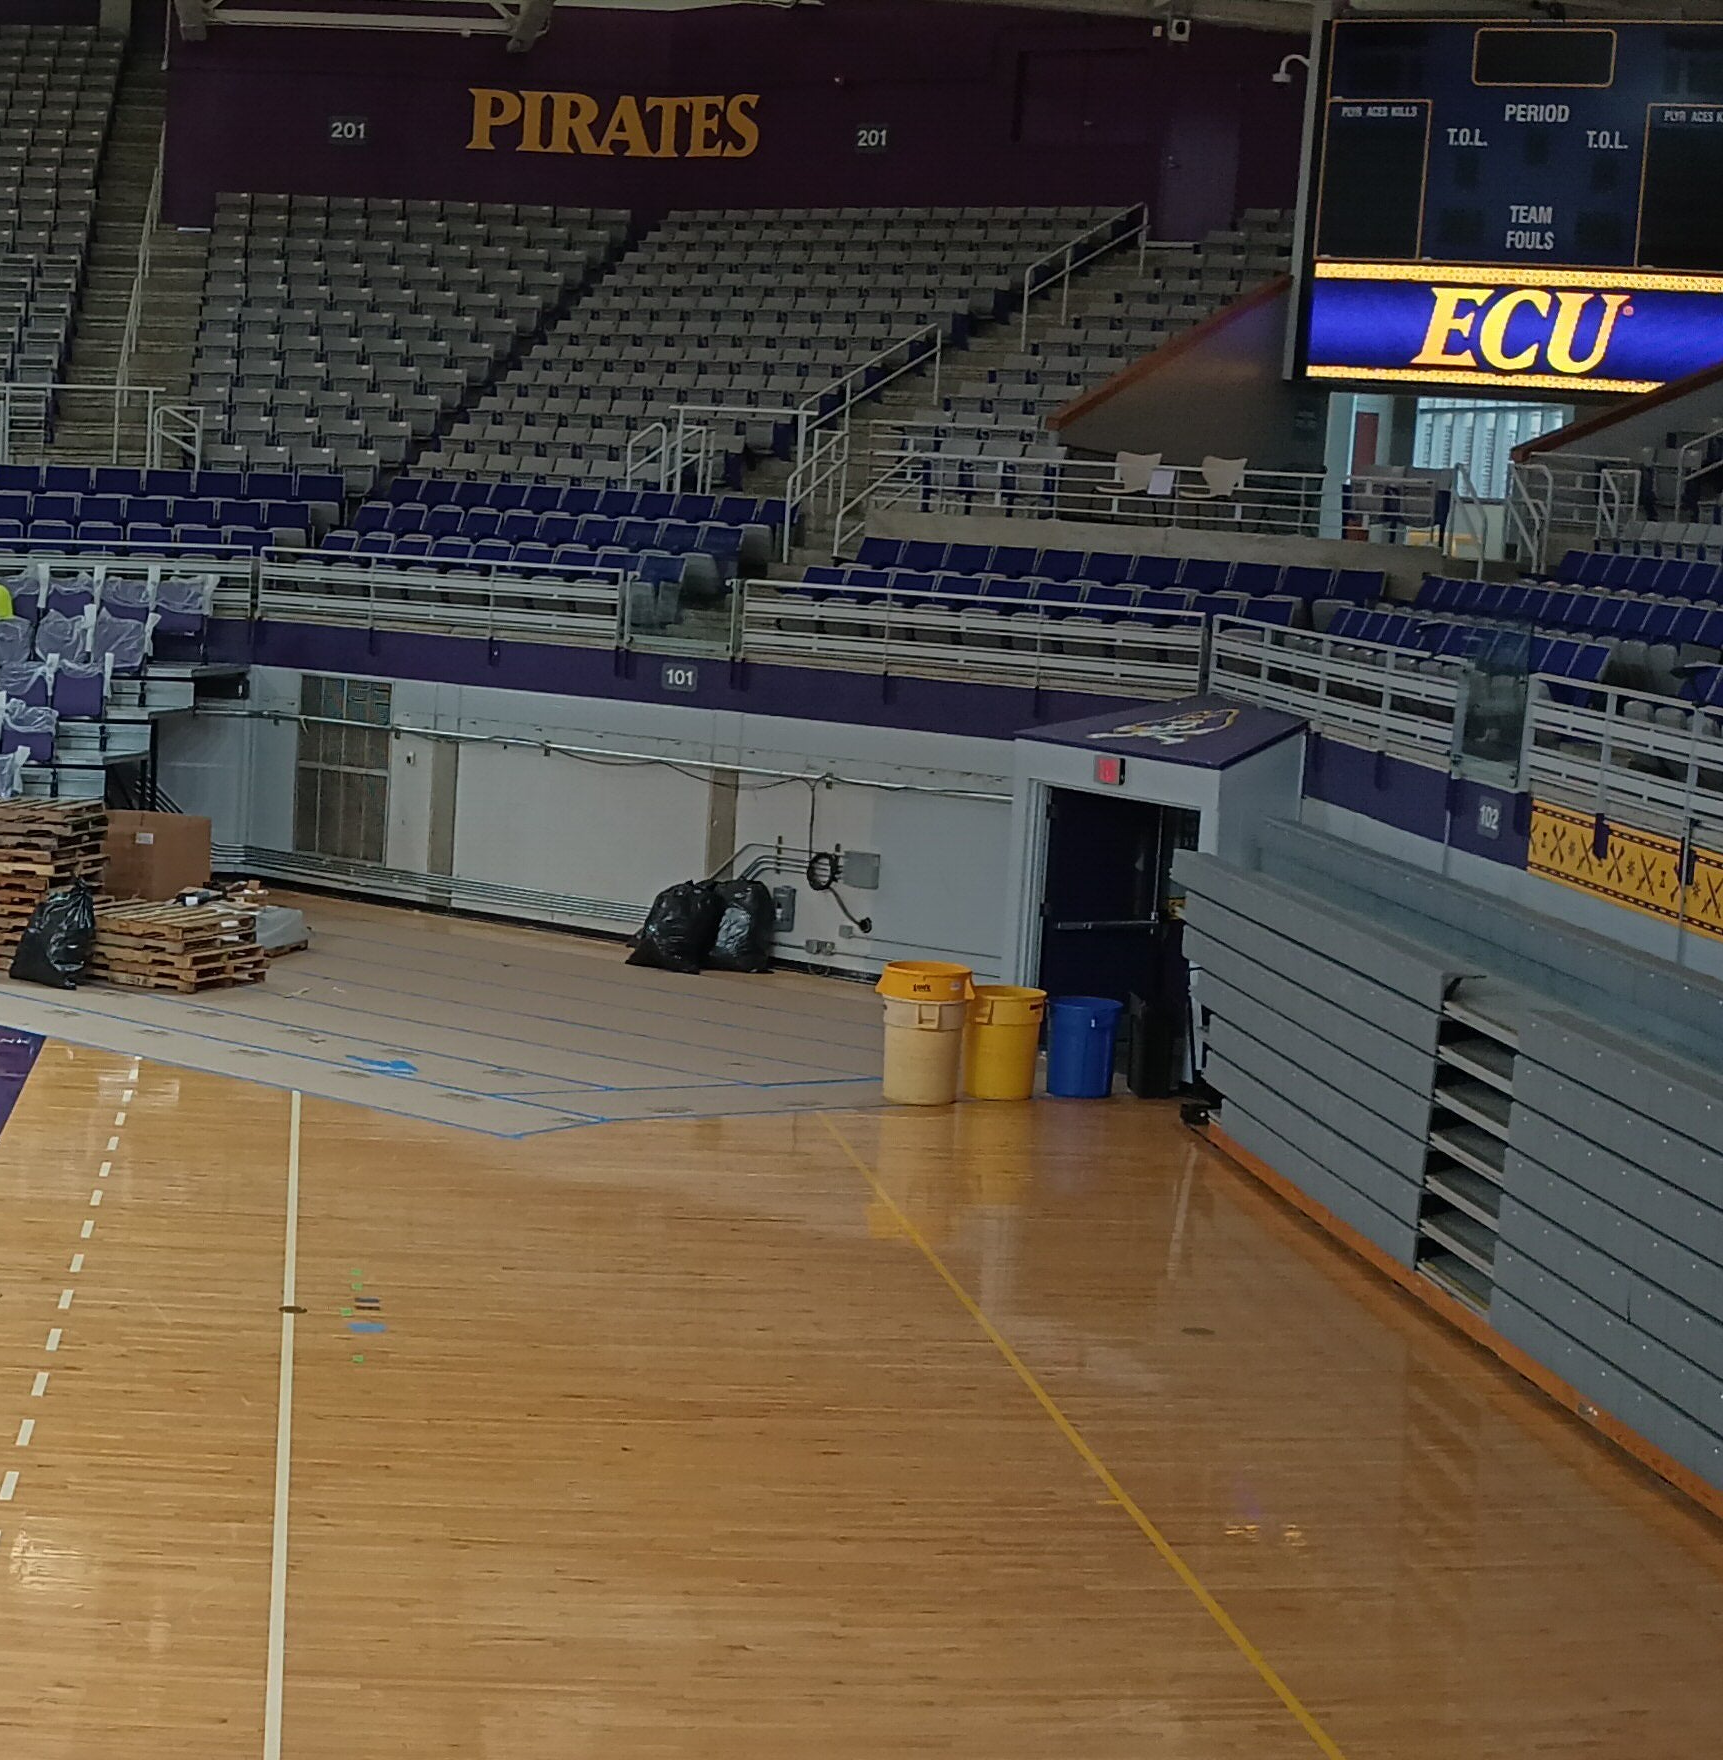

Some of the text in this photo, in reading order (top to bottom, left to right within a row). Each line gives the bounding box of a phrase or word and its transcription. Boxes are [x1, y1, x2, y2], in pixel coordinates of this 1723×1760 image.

[466, 88, 760, 157] PIRATES
[1504, 104, 1570, 123] PERIOD
[1691, 111, 1713, 123] ACES
[330, 122, 365, 139] 201
[857, 129, 887, 147] 201
[1447, 128, 1488, 147] T.O.L.
[1586, 130, 1629, 150] T.O.L.
[1509, 205, 1553, 225] TEAM
[1505, 230, 1555, 251] FOULS
[1410, 286, 1631, 374] ECU
[666, 668, 693, 686] 101
[1480, 805, 1500, 830] 102
